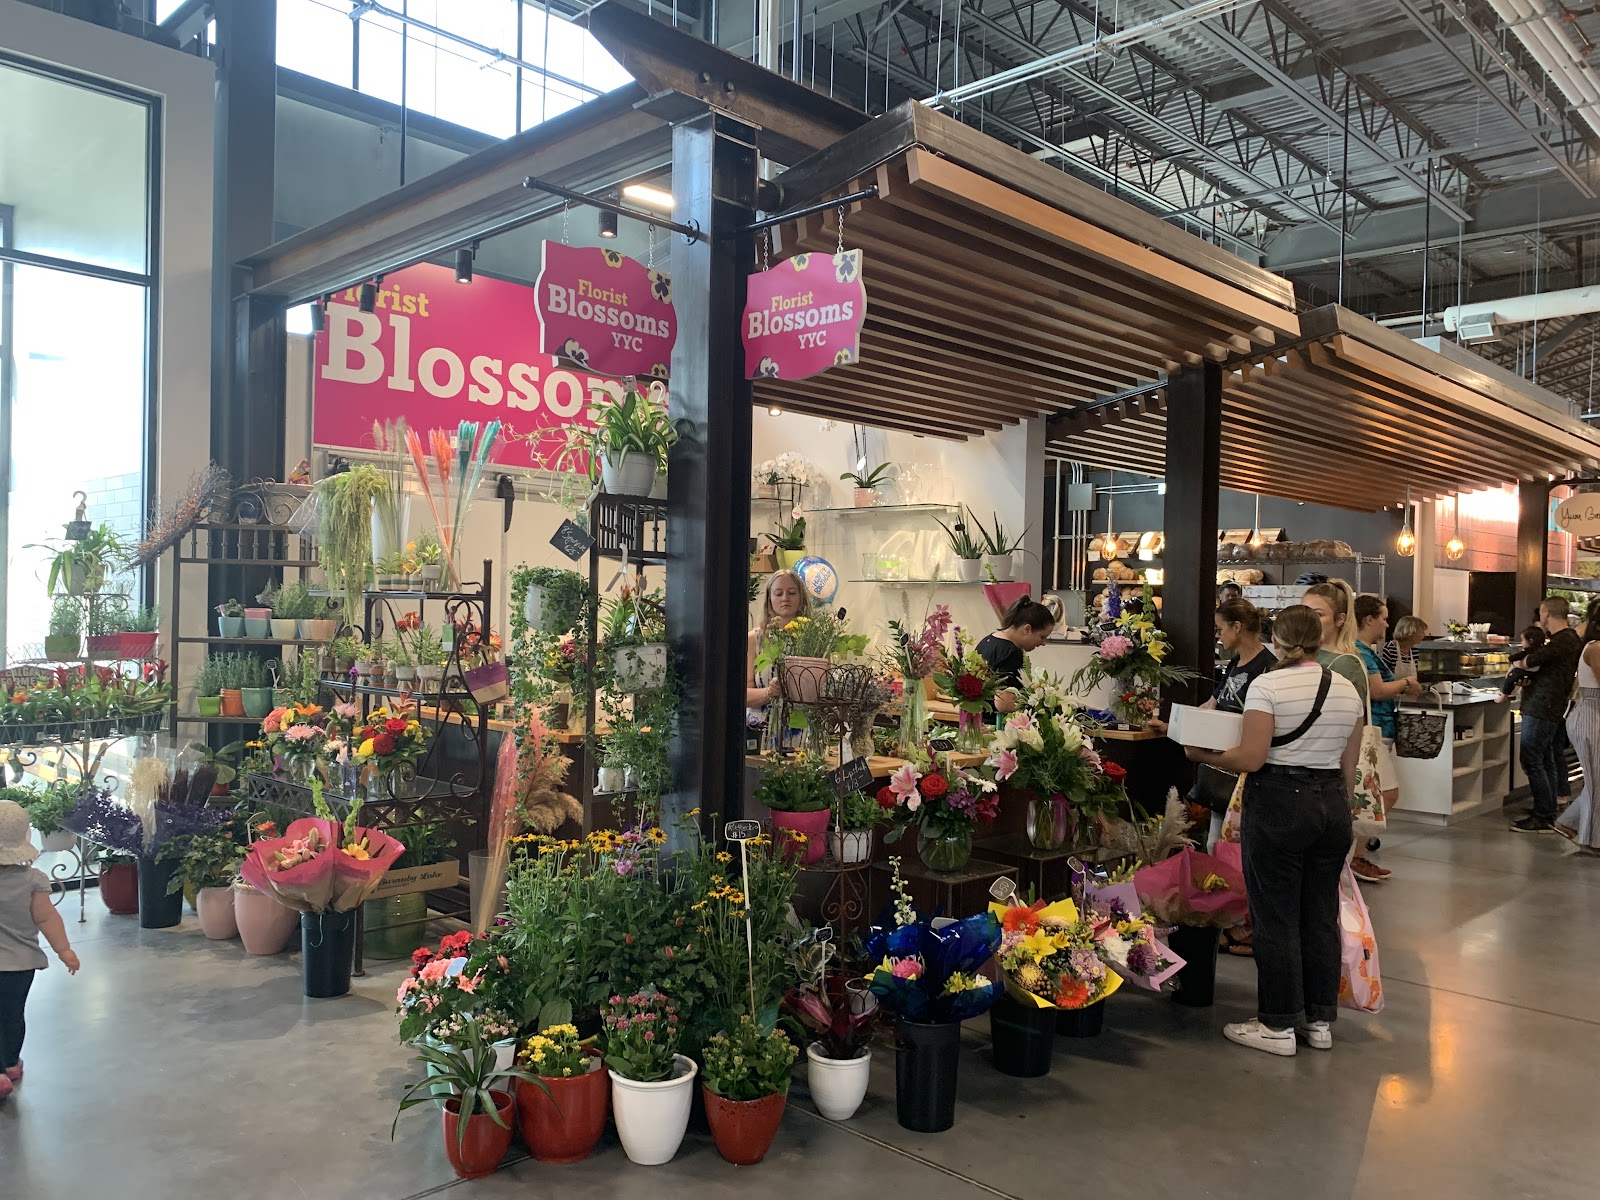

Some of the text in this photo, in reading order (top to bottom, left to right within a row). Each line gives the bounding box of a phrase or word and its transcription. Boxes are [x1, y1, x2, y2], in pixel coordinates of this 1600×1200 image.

[331, 284, 429, 317] rist
[578, 279, 628, 306] Florist
[771, 291, 813, 313] Florist
[547, 283, 670, 338] Blossoms
[748, 301, 854, 339] Blossoms
[611, 331, 643, 352] YYC
[798, 330, 827, 349] YYC
